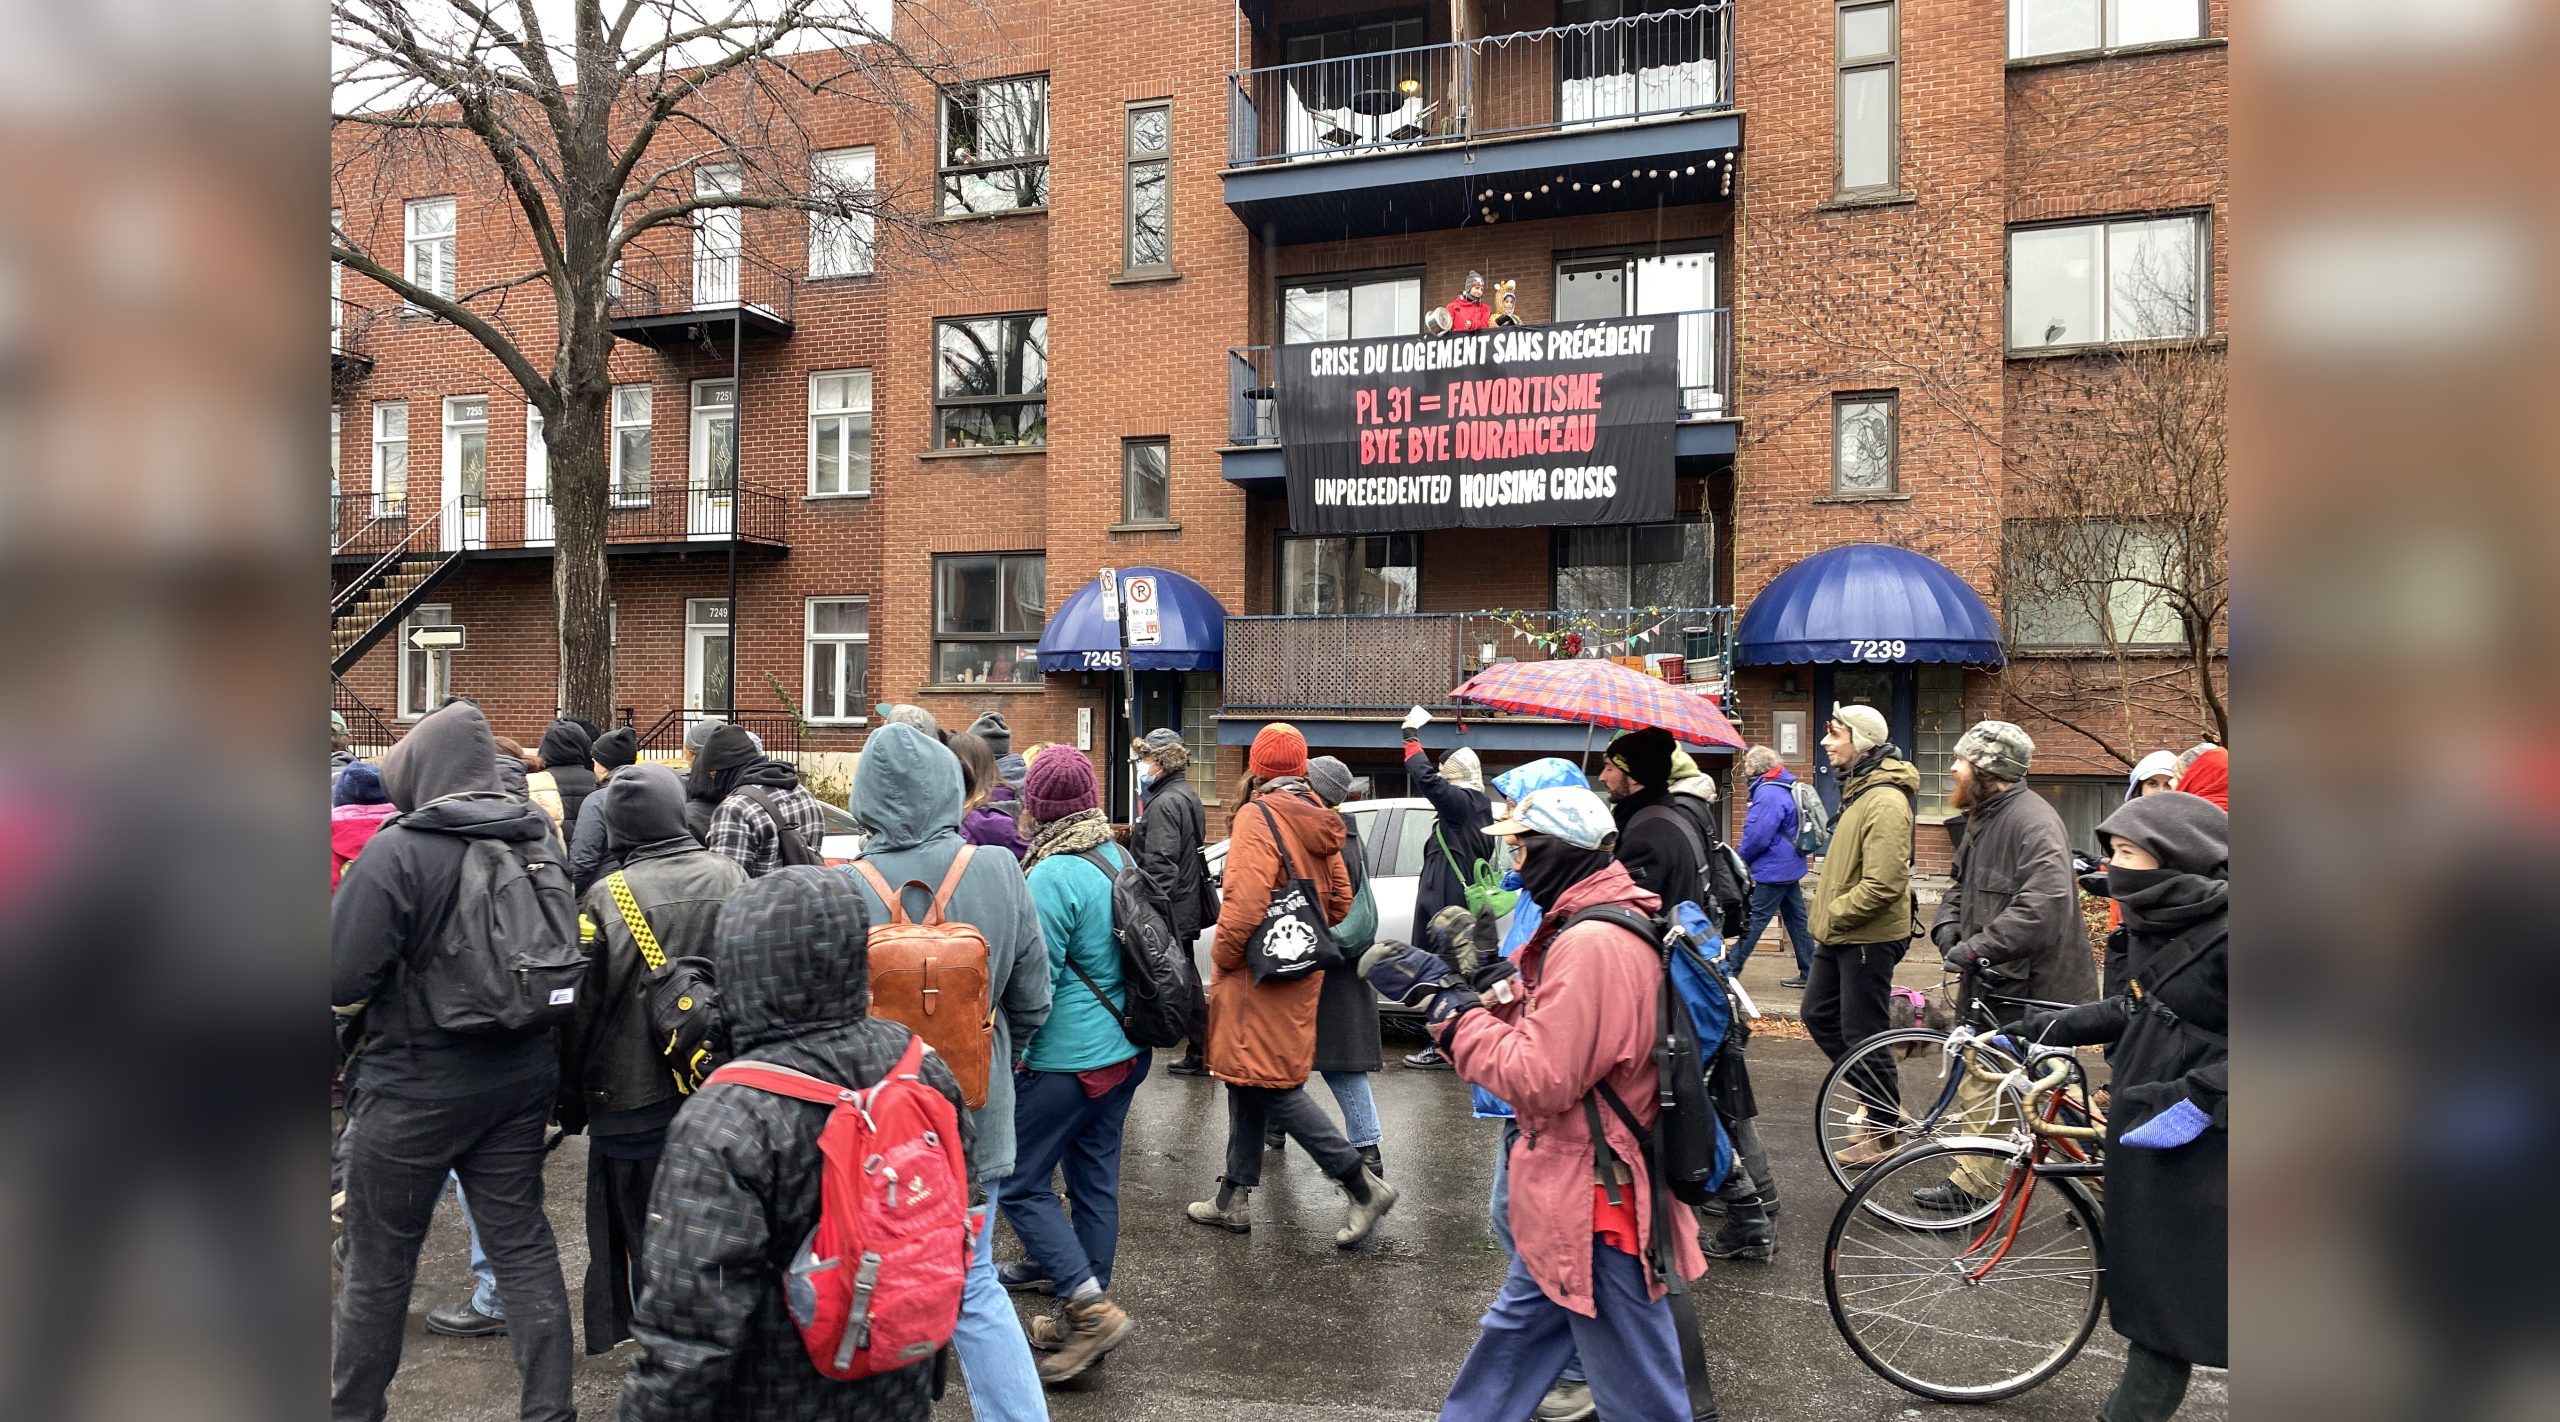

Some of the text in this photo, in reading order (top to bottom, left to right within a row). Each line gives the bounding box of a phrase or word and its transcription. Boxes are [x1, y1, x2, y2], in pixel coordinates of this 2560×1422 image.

[1311, 321, 1655, 377] CRISE DU LOGEMENT SANS PRÉCÉDENT
[715, 391, 733, 401] 7251
[1356, 389, 1383, 425] PL
[1387, 386, 1412, 423] 31
[1447, 373, 1603, 418] FAVORITISME
[466, 406, 483, 417] 7255
[1360, 414, 1597, 465] BYE BYE DURANCEAU
[1315, 465, 1617, 508] UNPRECEDENTED HOUSING CRISIS
[709, 607, 728, 618] 7249
[1850, 640, 1906, 658] 7239
[1082, 651, 1122, 667] 7245
